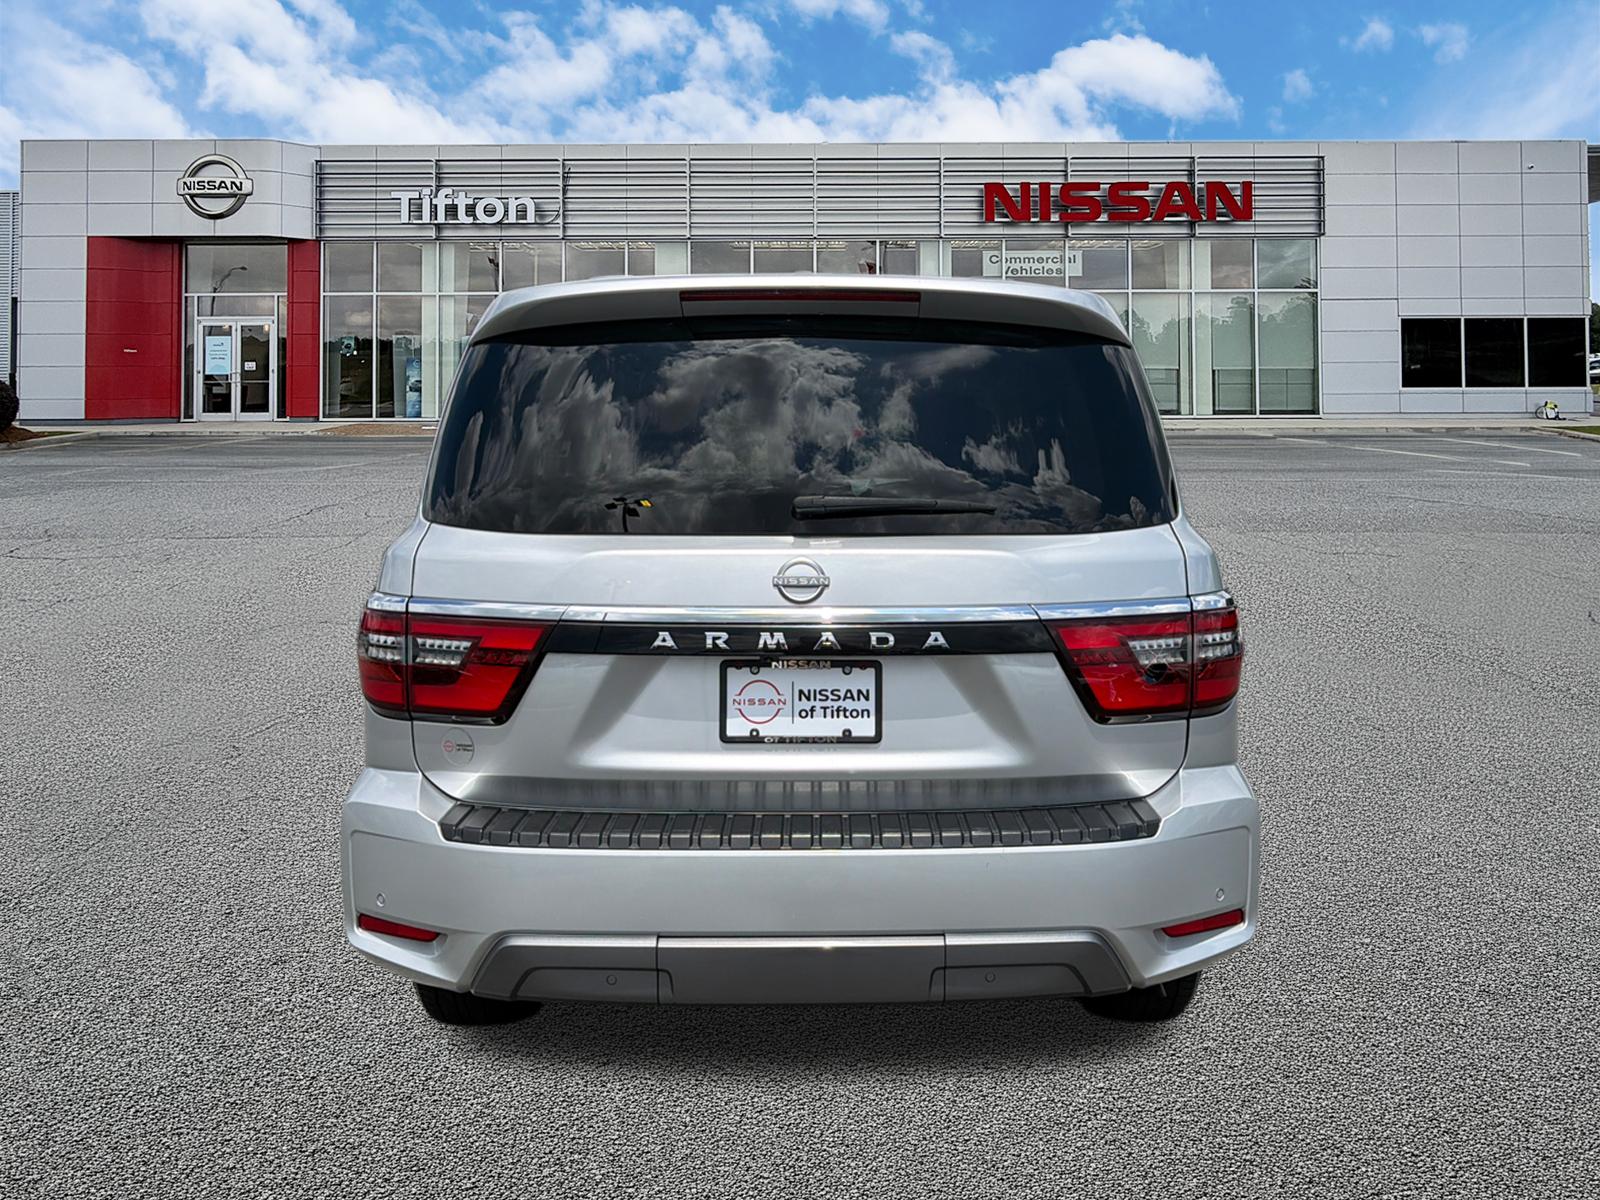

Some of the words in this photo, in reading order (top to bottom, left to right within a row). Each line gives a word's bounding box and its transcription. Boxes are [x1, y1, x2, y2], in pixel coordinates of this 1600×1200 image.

[182, 180, 243, 191] NISSAN
[391, 188, 536, 224] Tifton
[984, 181, 1253, 221] NISSAN
[773, 576, 830, 586] NISSAN
[650, 632, 951, 649] ARMADA
[771, 660, 832, 670] NISSAN
[732, 698, 787, 706] NISSAN
[798, 688, 870, 702] NISSAN
[798, 705, 816, 719] of
[820, 705, 871, 719] Tifton
